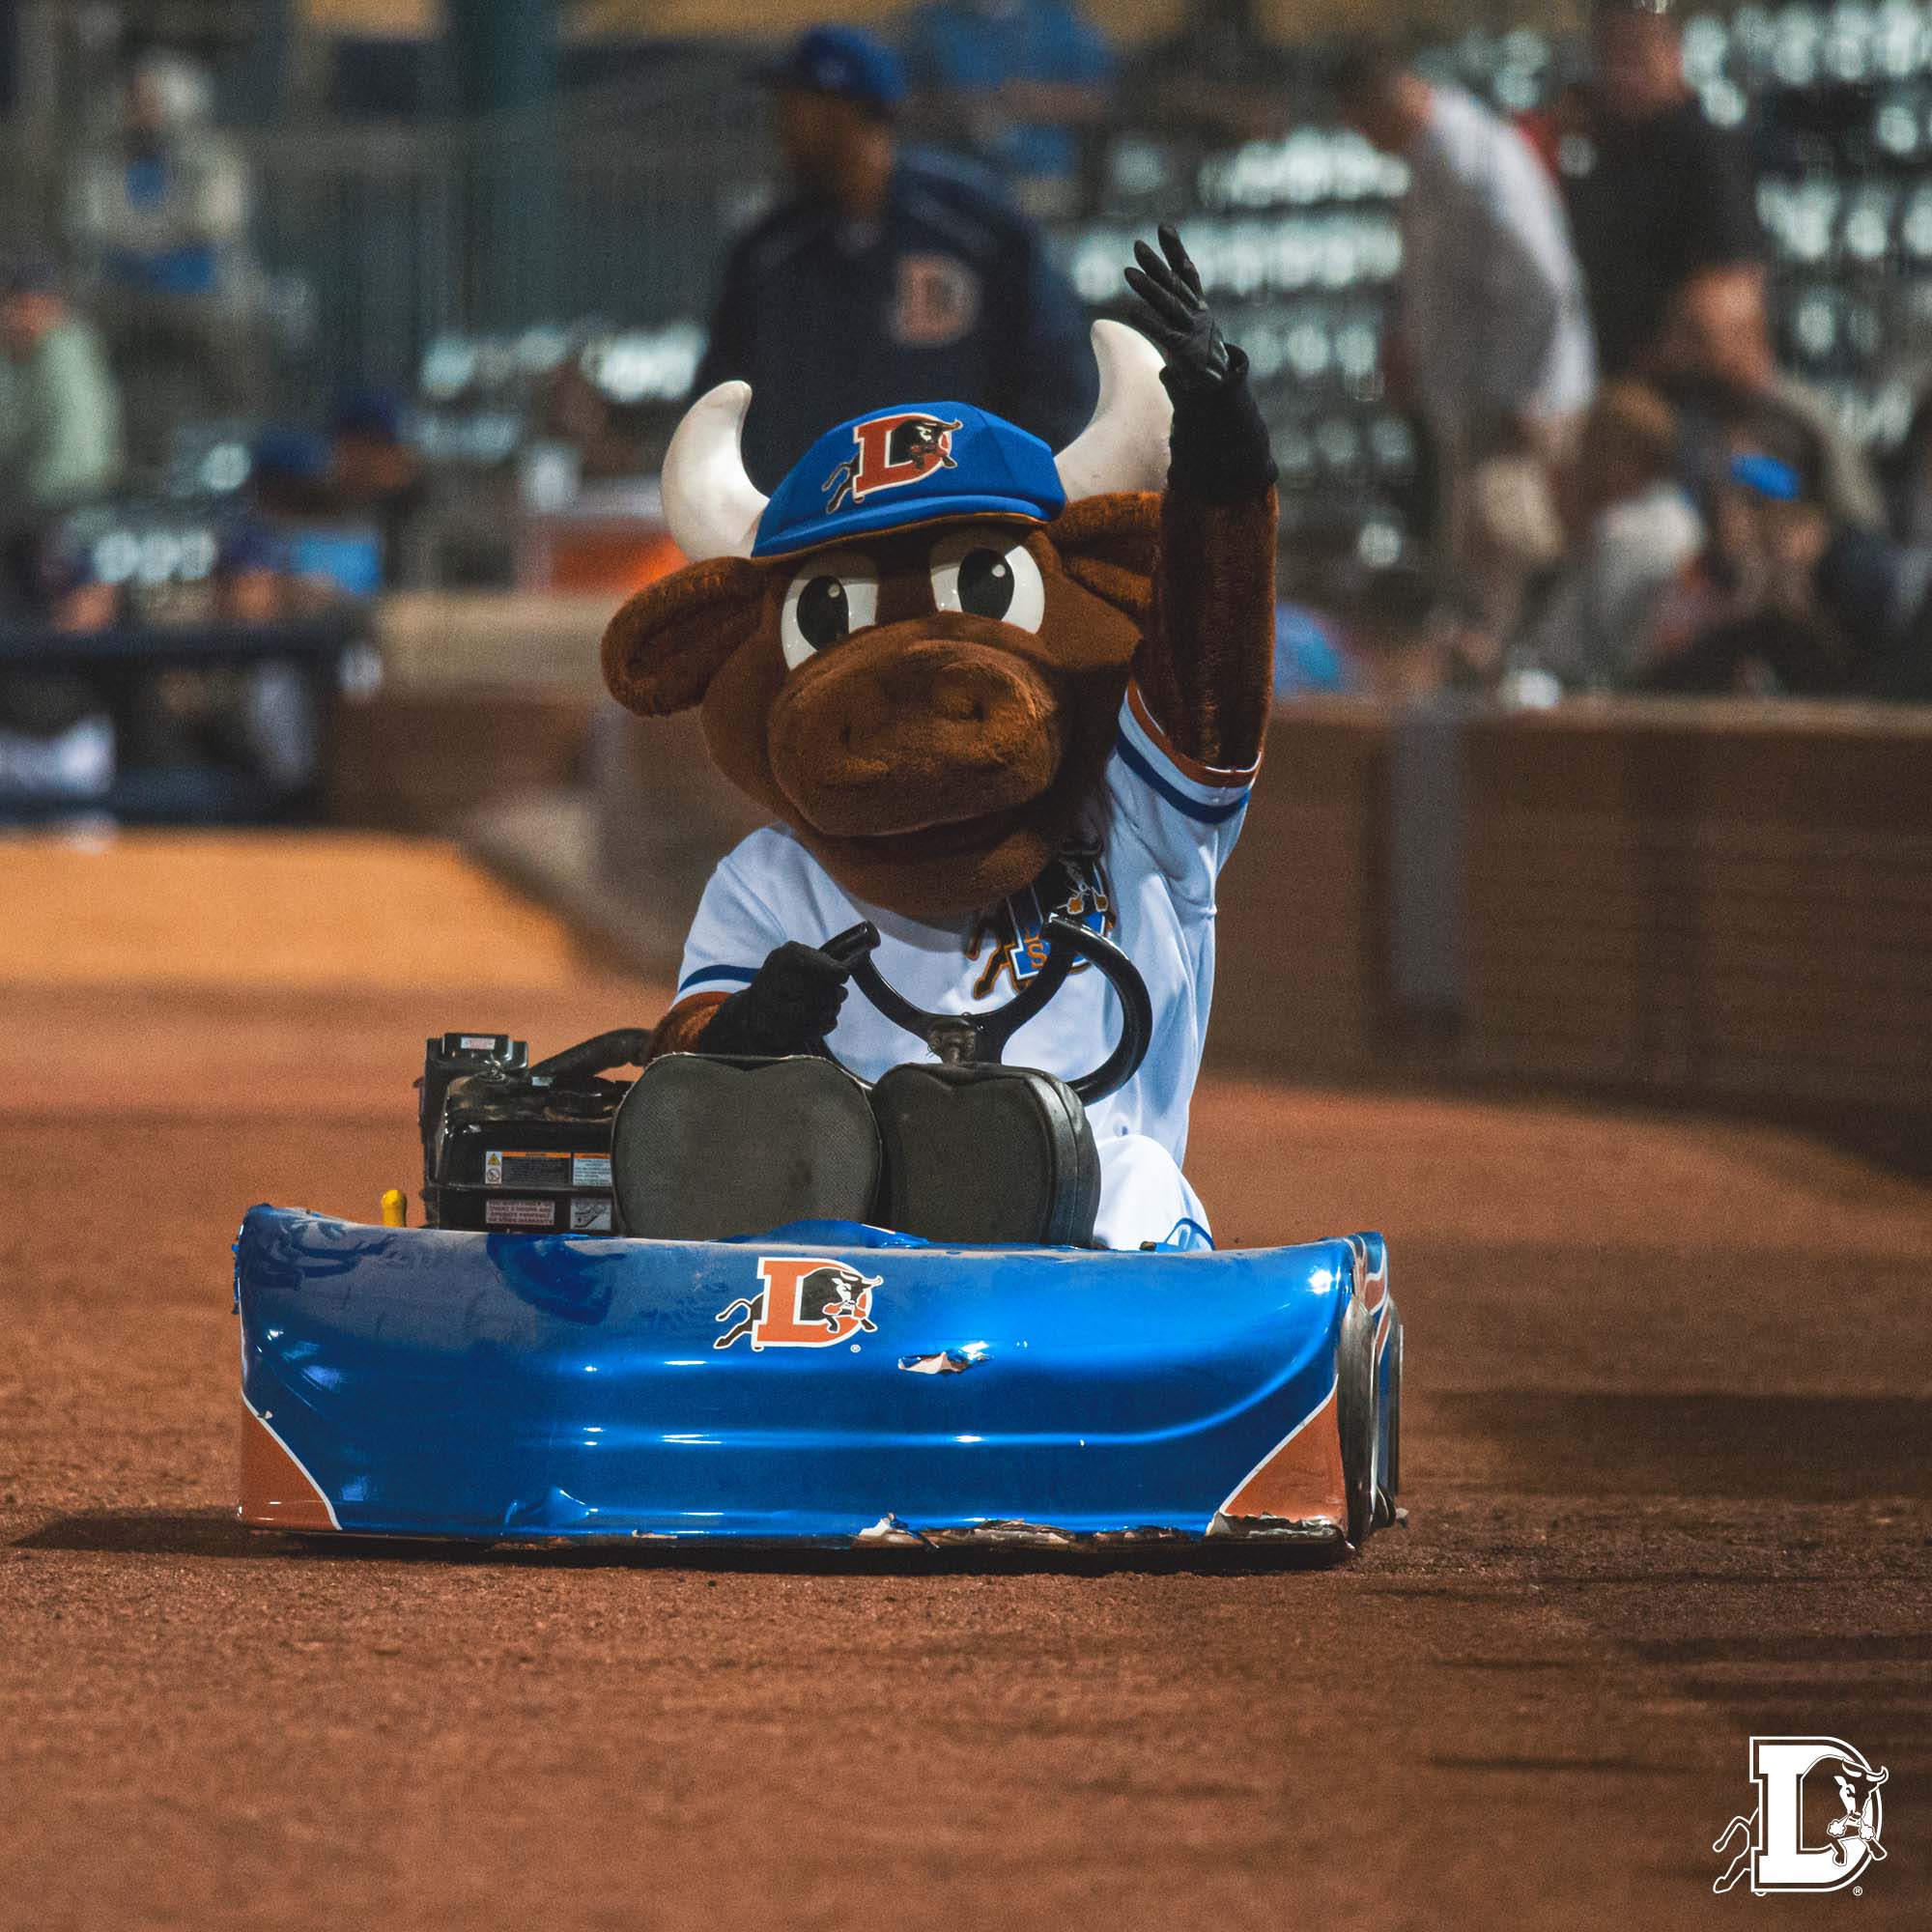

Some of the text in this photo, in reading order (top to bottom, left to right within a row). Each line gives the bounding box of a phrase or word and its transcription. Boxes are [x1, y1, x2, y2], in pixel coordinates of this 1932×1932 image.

[895, 254, 979, 342] D
[853, 412, 952, 497] D
[752, 1257, 872, 1348] D
